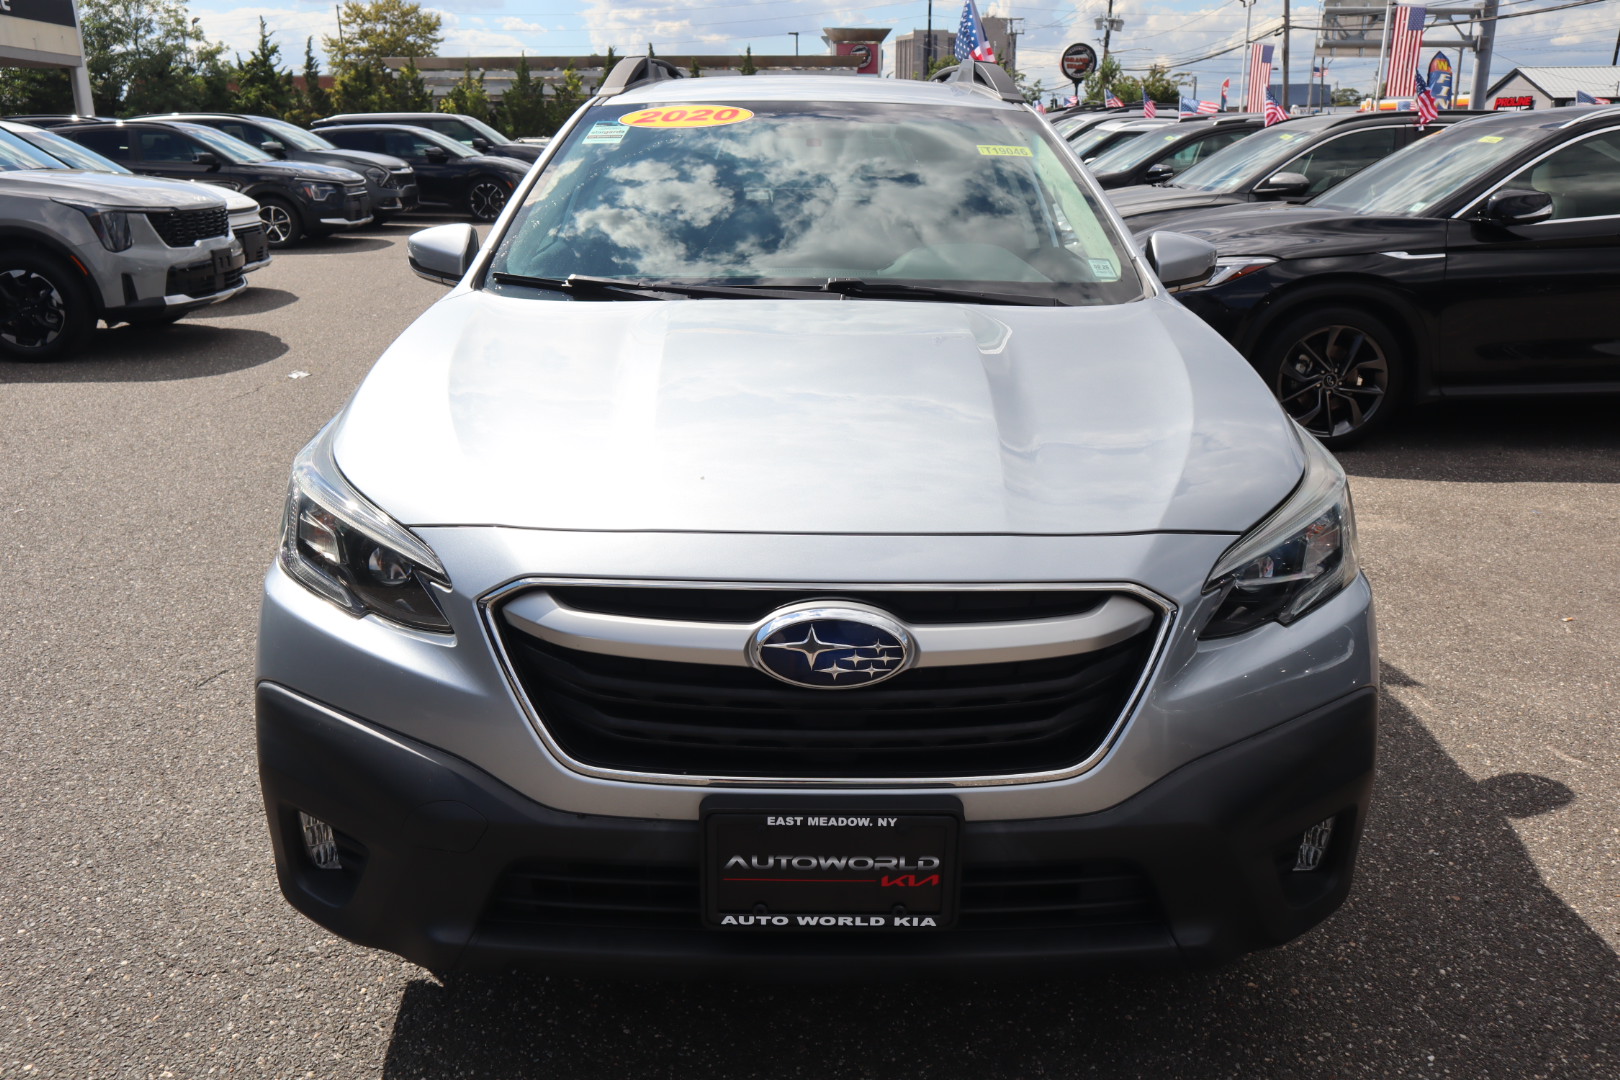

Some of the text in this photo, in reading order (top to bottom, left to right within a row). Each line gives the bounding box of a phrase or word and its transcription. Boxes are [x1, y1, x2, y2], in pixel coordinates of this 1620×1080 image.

[1493, 96, 1533, 110] PROLINE
[632, 109, 740, 123] 2020
[767, 816, 804, 826] EAST
[877, 817, 898, 827] NY
[723, 855, 941, 871] AUTOWORLD
[880, 874, 941, 887] KIA
[720, 915, 937, 927] AUTO WORLD KIA
